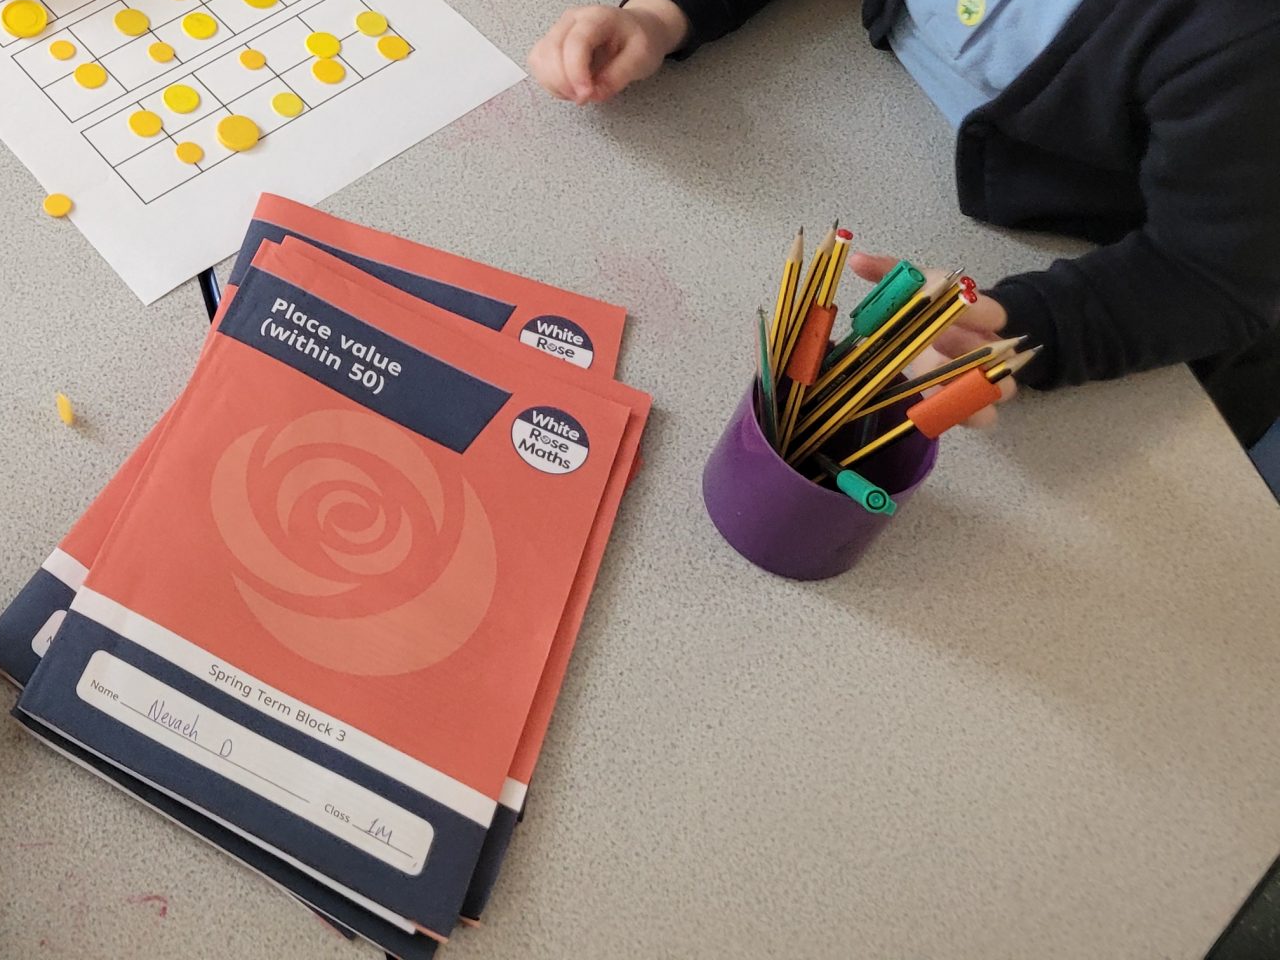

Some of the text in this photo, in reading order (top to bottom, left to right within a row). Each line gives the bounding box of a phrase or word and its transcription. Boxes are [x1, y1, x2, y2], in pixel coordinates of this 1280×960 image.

[271, 297, 402, 376] Place value
[536, 319, 584, 346] White
[536, 336, 575, 359] Rose
[260, 317, 385, 394] (within 50)
[529, 427, 569, 453] Rose
[532, 409, 580, 441] White
[518, 438, 571, 470] Maths
[90, 679, 119, 701] Name
[208, 664, 347, 742] Spring Term Block 3
[147, 699, 233, 758] Nevaeh D
[324, 803, 351, 823] Class
